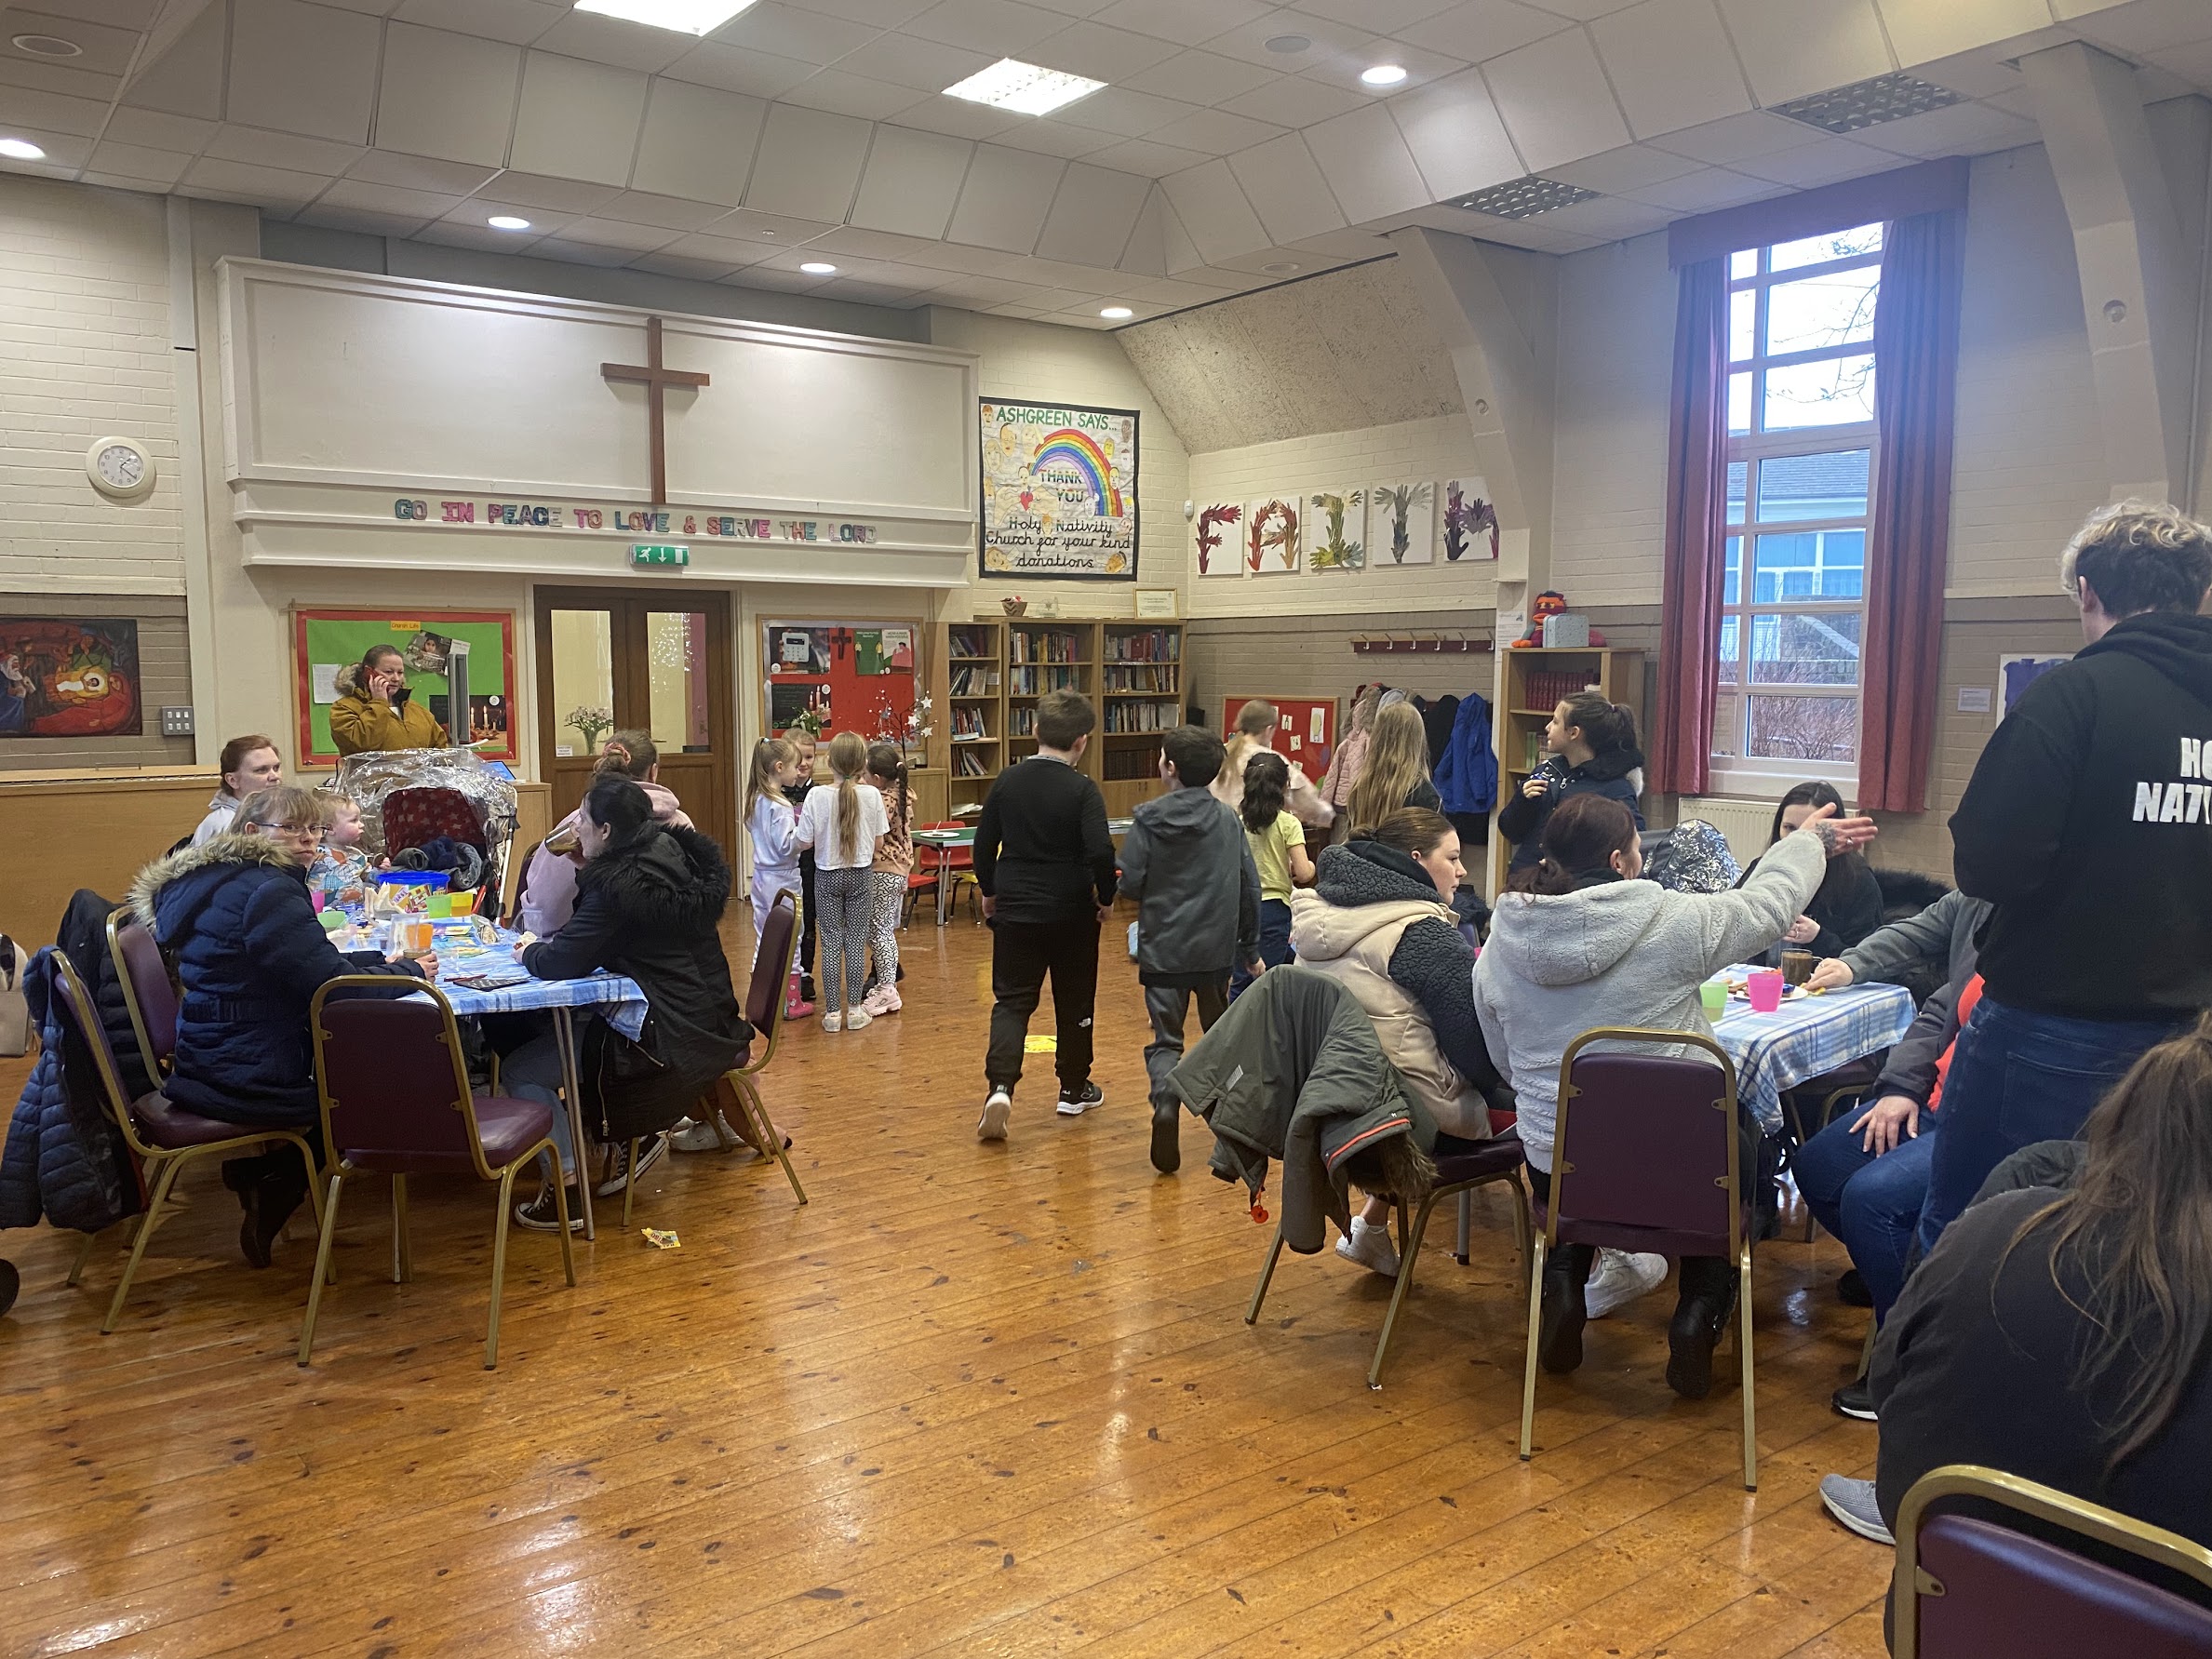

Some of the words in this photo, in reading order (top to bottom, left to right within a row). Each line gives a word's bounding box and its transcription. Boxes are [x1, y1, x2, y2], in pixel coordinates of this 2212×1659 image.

[996, 407, 1072, 426] ASHGREEN
[1039, 469, 1082, 484] THANK
[1056, 488, 1084, 502] YOU
[395, 499, 428, 520] GO
[441, 502, 475, 523] IN
[488, 503, 563, 528] PEACE
[573, 509, 603, 529] TO
[615, 511, 670, 533] LOVE
[683, 515, 697, 534] &
[706, 516, 771, 539] SERVE
[780, 520, 818, 541] THE
[828, 523, 878, 544] LORD
[1010, 515, 1042, 535] Holy
[1056, 519, 1113, 538] Nativity
[985, 530, 1034, 546] Church
[1036, 536, 1059, 556] for
[1061, 536, 1097, 551] your
[1099, 535, 1131, 549] kind
[1016, 553, 1095, 568] donations
